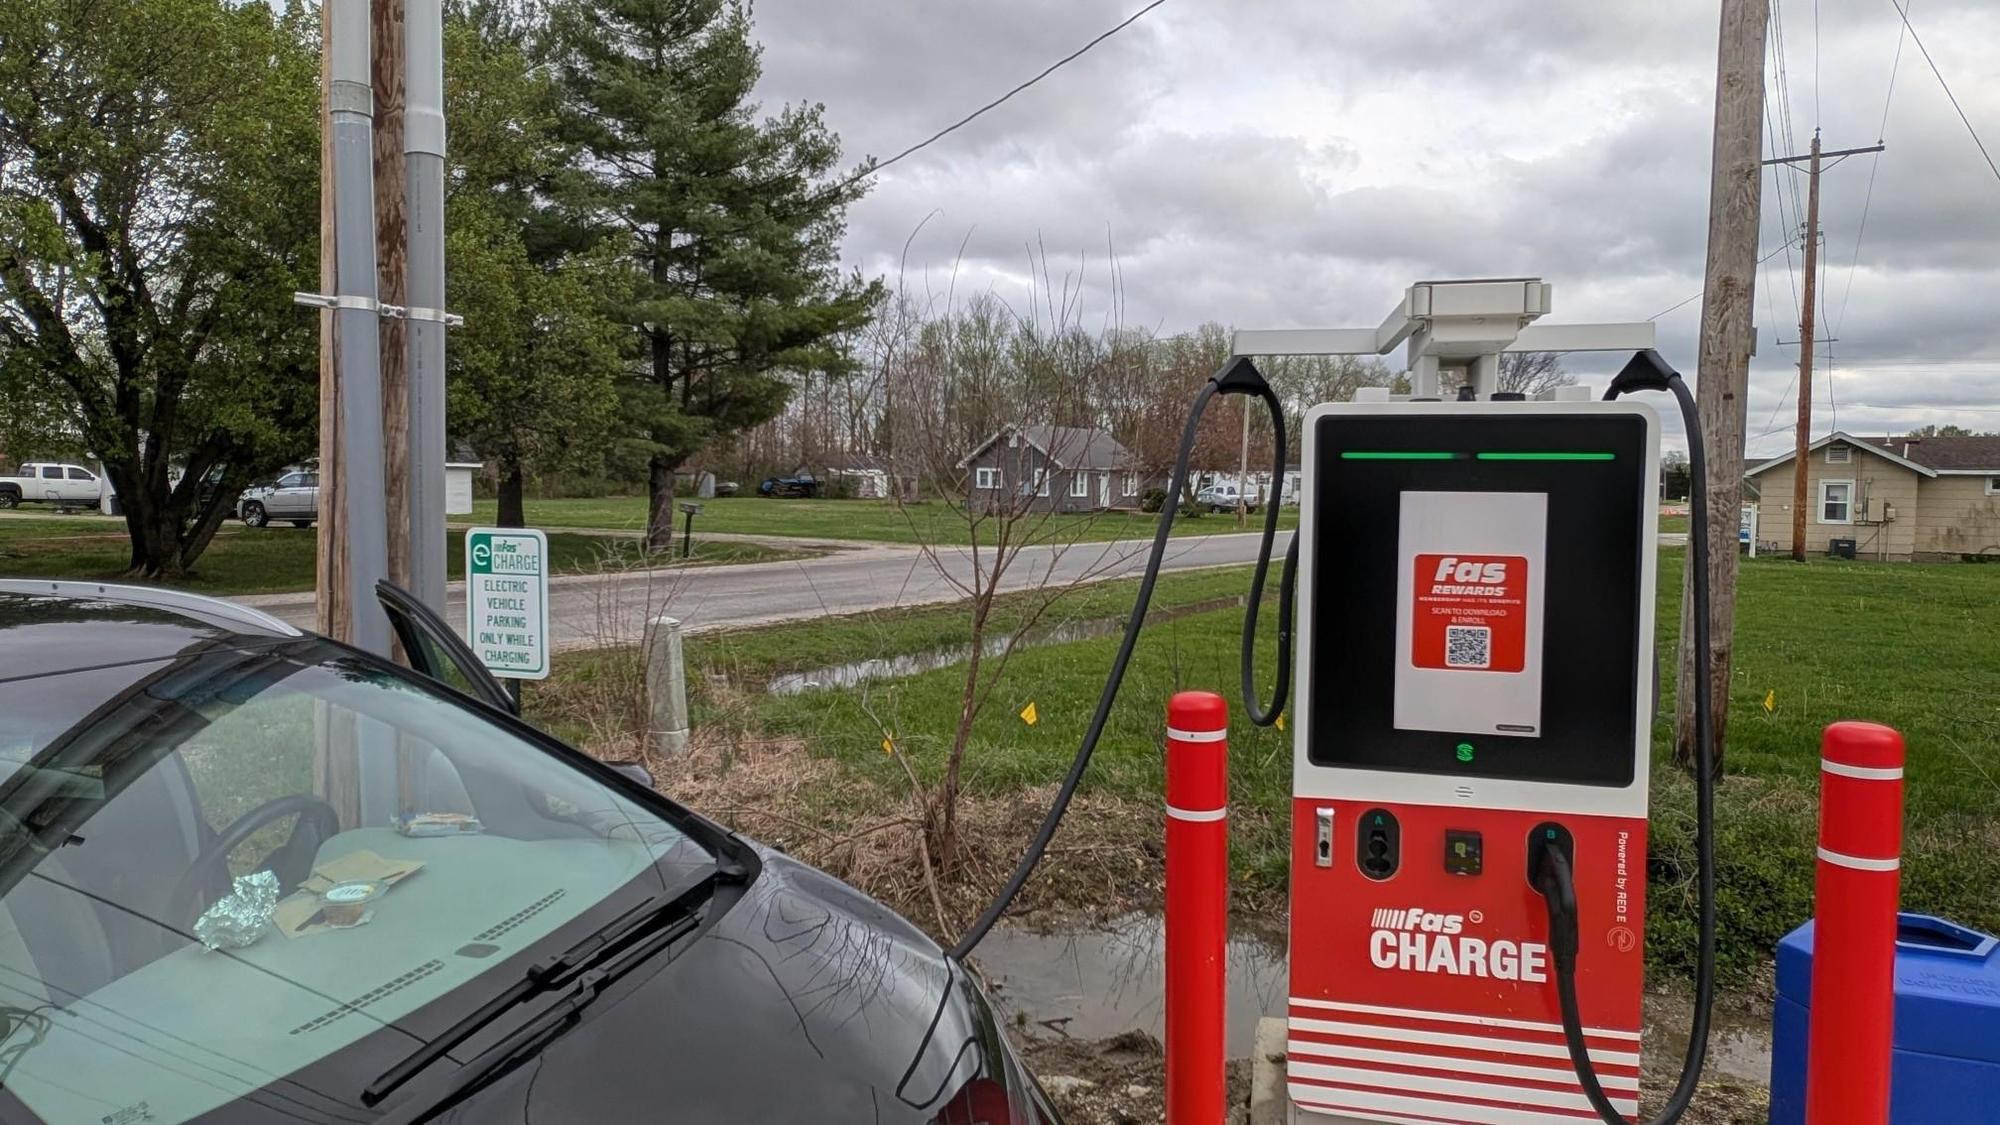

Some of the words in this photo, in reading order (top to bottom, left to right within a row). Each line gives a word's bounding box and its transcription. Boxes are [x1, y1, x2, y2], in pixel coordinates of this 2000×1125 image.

[494, 554, 538, 571] CHARGE
[1434, 557, 1507, 584] Fas
[484, 579, 528, 593] ELECTRIC
[1431, 585, 1507, 596] REWARDS
[487, 597, 525, 611] VEHICLE
[1431, 607, 1452, 615] SCAN
[1452, 607, 1462, 615] TO
[1462, 608, 1507, 616] DOWNLOAD
[487, 615, 527, 628] PARKING
[1457, 616, 1486, 625] ENROLL
[480, 632, 503, 645] ONLY
[506, 634, 534, 647] WHILE
[485, 649, 530, 664] CHARGING
[1617, 831, 1629, 876] Powered
[1615, 878, 1627, 890] by
[1616, 915, 1627, 923] E
[1370, 929, 1547, 983] CHARGE
